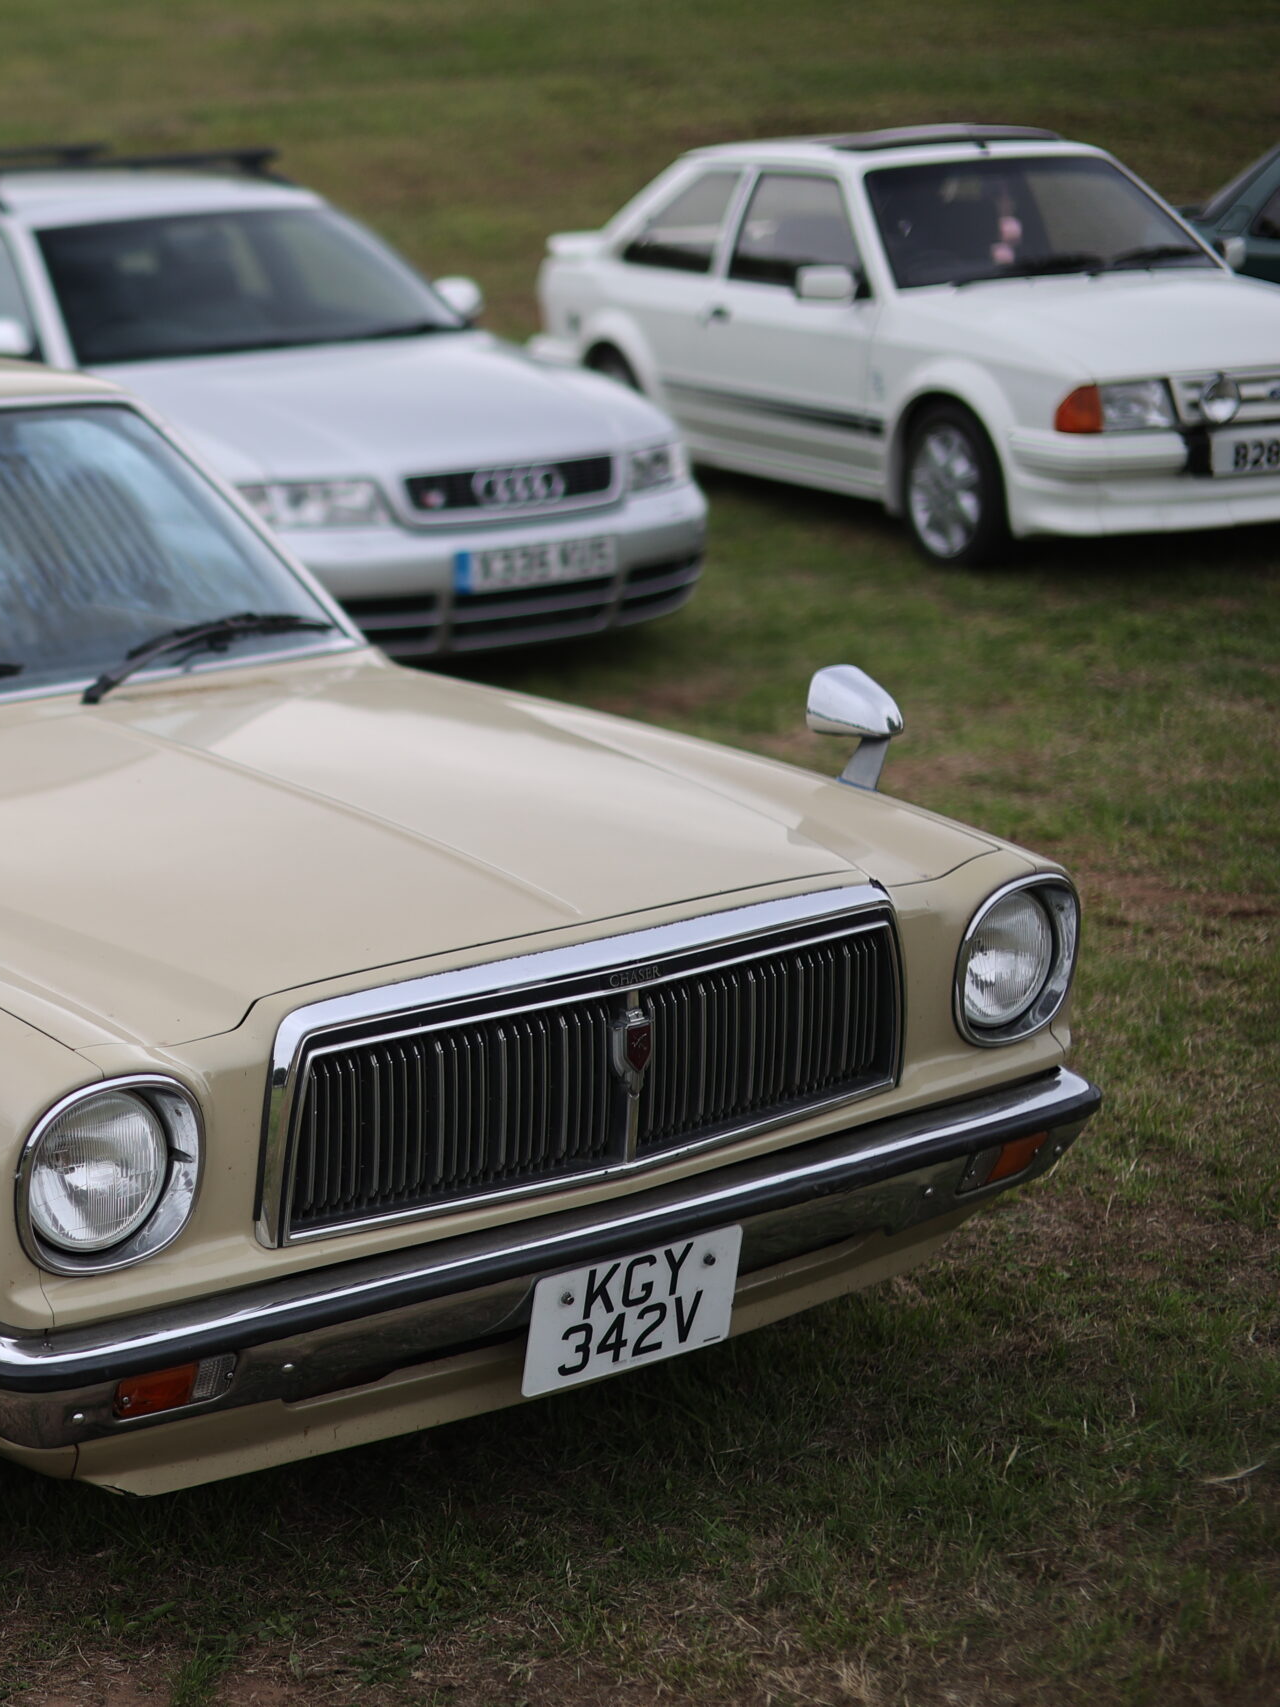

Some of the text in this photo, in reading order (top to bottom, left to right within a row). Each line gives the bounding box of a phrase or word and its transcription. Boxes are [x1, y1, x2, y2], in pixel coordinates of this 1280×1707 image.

[609, 965, 662, 988] CHASER
[582, 1241, 694, 1320] KGY
[557, 1289, 704, 1377] 342V
